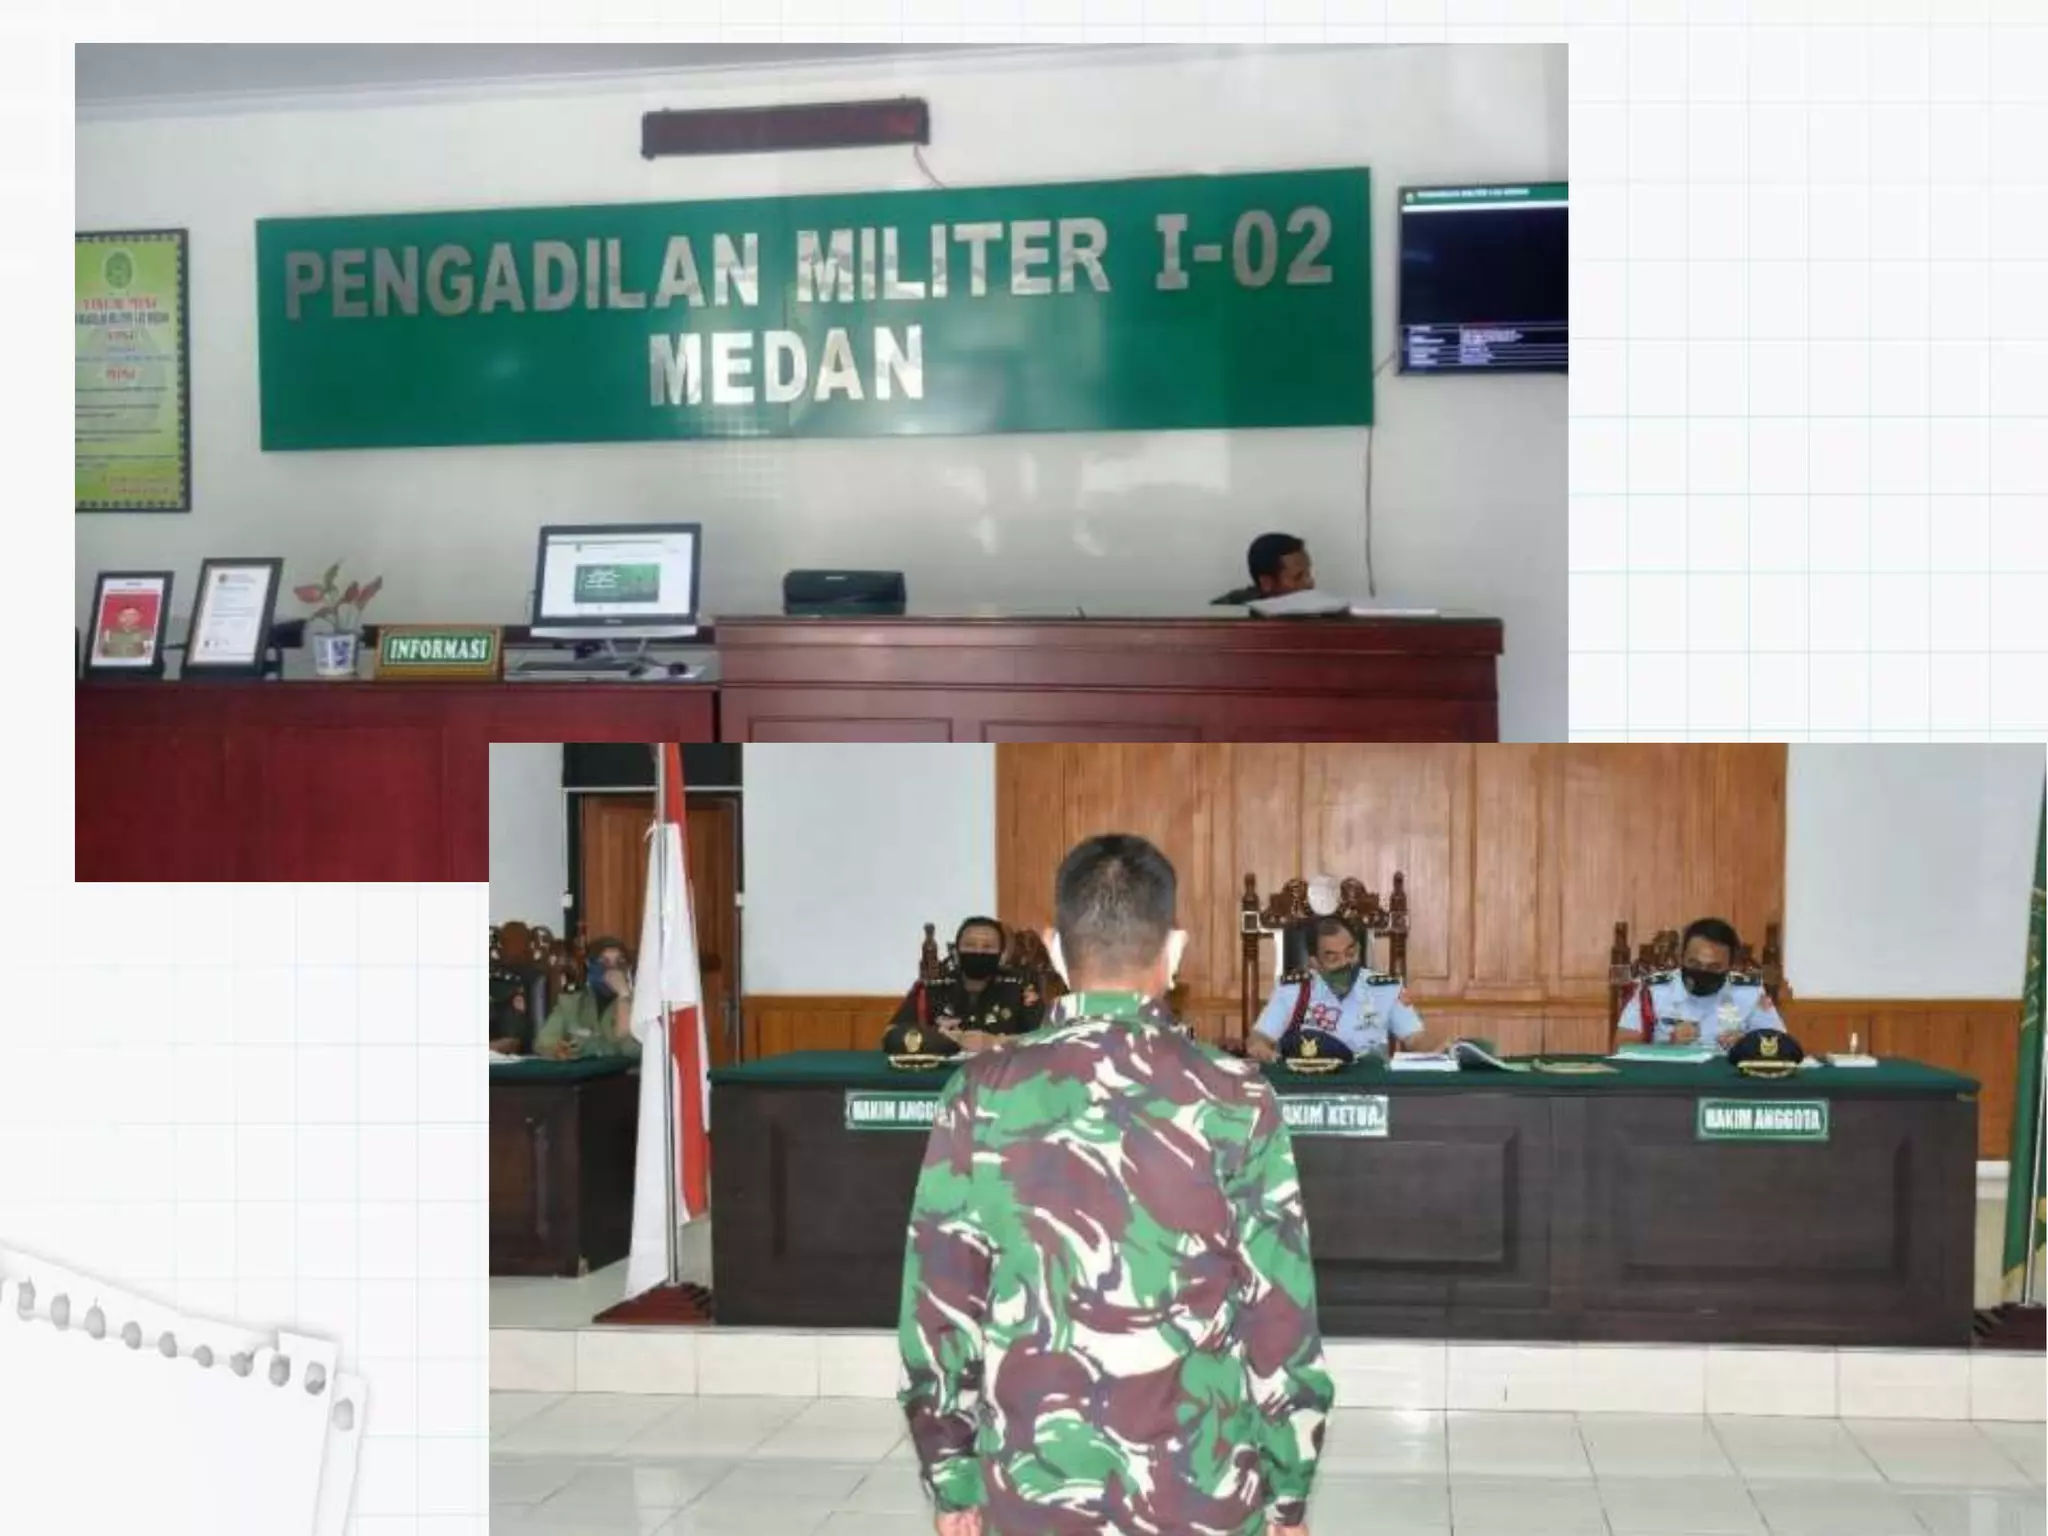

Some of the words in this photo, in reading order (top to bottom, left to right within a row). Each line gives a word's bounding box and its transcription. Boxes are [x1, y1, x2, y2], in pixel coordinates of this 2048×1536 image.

[284, 232, 760, 320] PENGADILAN
[796, 217, 1111, 302] MILITER
[1155, 206, 1333, 289] I-02
[648, 324, 925, 406] MEDAN
[389, 638, 487, 659] INFORMASI
[852, 1100, 896, 1121] HAKIM
[1282, 1103, 1324, 1126] AKIM
[1327, 1104, 1378, 1127] KETUA
[1705, 1107, 1752, 1130] HAKIM
[1754, 1107, 1820, 1130] ANGGOTA
